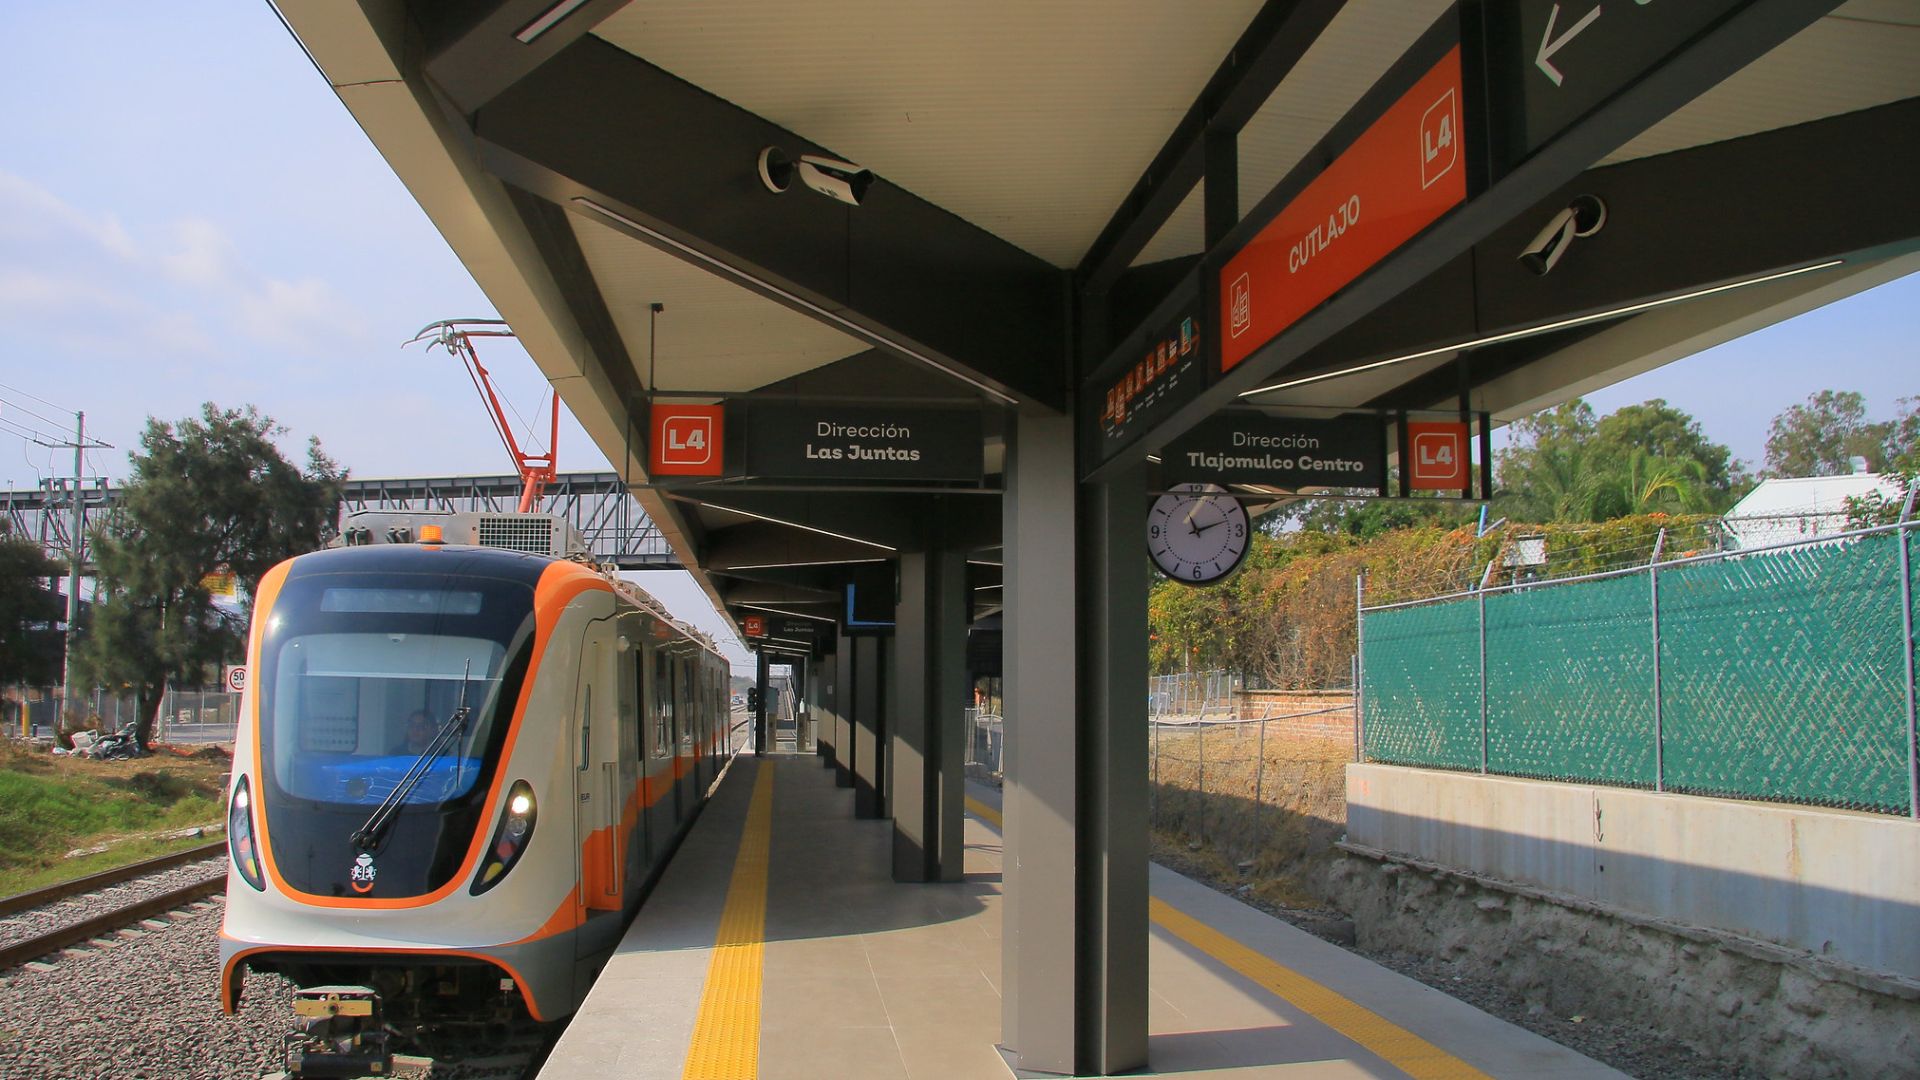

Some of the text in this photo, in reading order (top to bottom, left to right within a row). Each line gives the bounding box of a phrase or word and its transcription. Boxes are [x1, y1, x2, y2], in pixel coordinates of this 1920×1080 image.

[1425, 114, 1452, 163] L4
[1289, 194, 1361, 274] CUTLAJO
[817, 421, 910, 438] Dirección
[669, 429, 706, 449] L4
[1233, 431, 1320, 449] Dirección
[806, 443, 921, 460] Las Juntas
[1421, 445, 1453, 464] L4
[1187, 452, 1364, 472] Tlajomulco Centro
[1151, 525, 1160, 539] 9
[1235, 524, 1244, 537] 3
[1192, 566, 1202, 579] 6
[233, 671, 245, 681] 50
